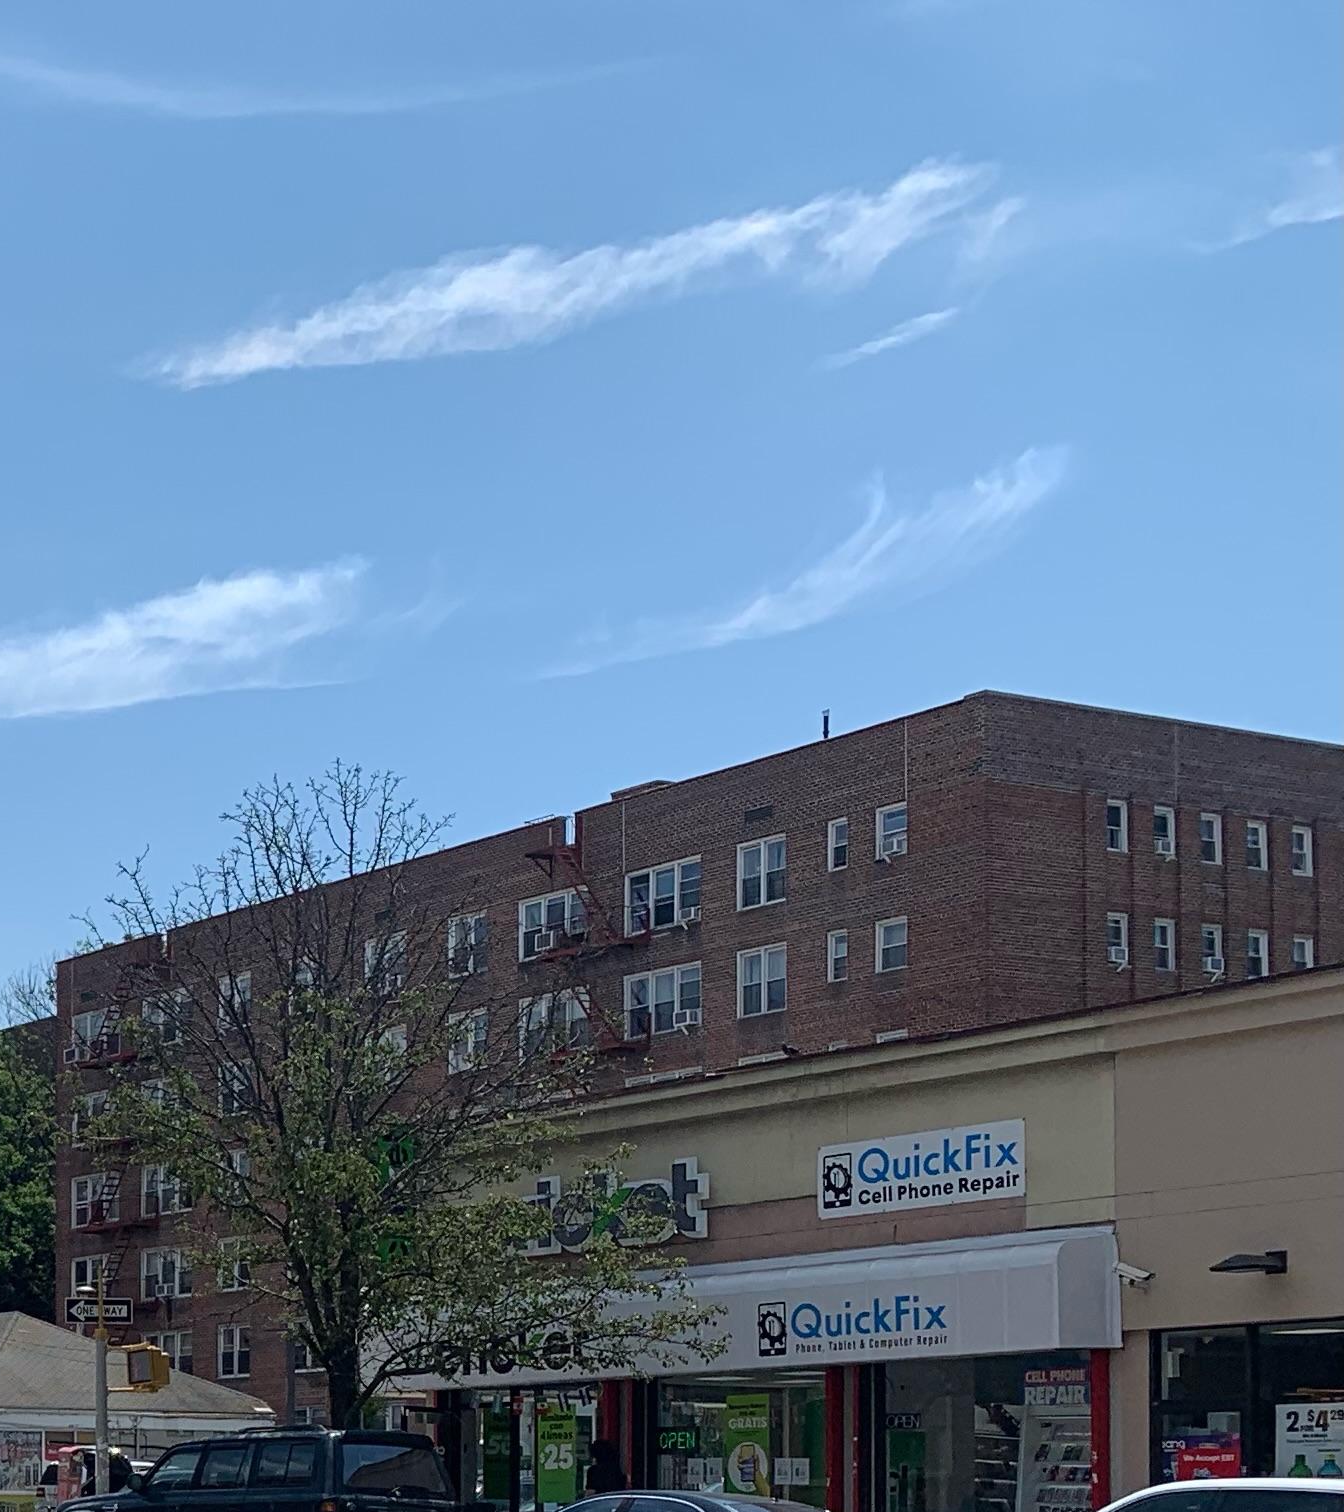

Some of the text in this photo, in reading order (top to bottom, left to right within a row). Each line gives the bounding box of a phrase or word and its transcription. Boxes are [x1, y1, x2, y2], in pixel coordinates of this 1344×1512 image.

[858, 1134, 1018, 1184] QuickFix
[858, 1170, 1020, 1205] Cell Phone Repair
[76, 1306, 123, 1316] ONE WAY
[791, 1296, 946, 1339] QuickFix
[829, 1340, 856, 1351] Tablet
[860, 1339, 865, 1349] &
[869, 1337, 912, 1350] Computer
[916, 1334, 948, 1346] Repair
[1025, 1369, 1085, 1383] CELL PHONE
[1024, 1385, 1085, 1405] REPAIR
[728, 1417, 767, 1429] GRATIS
[886, 1415, 920, 1428] OPEN
[1286, 1411, 1299, 1432] 2
[659, 1432, 695, 1449] OPEN
[540, 1444, 574, 1470] $25
